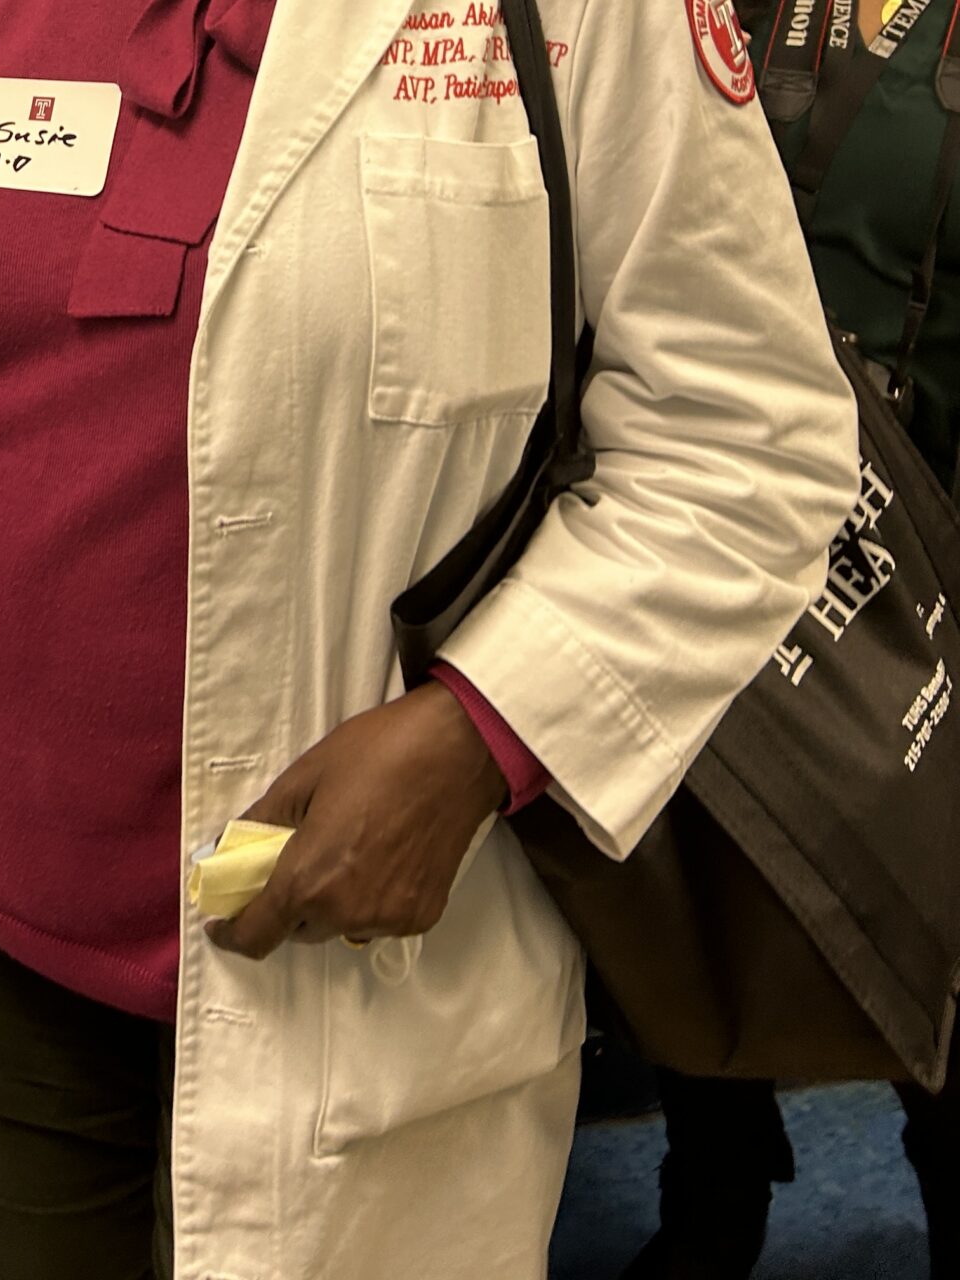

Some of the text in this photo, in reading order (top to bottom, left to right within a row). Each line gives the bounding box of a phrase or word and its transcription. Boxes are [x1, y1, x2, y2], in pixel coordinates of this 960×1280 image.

[402, 10, 455, 30] usan
[420, 37, 476, 66] MPA,
[393, 74, 438, 104] AVP,
[807, 536, 896, 643] HEA
